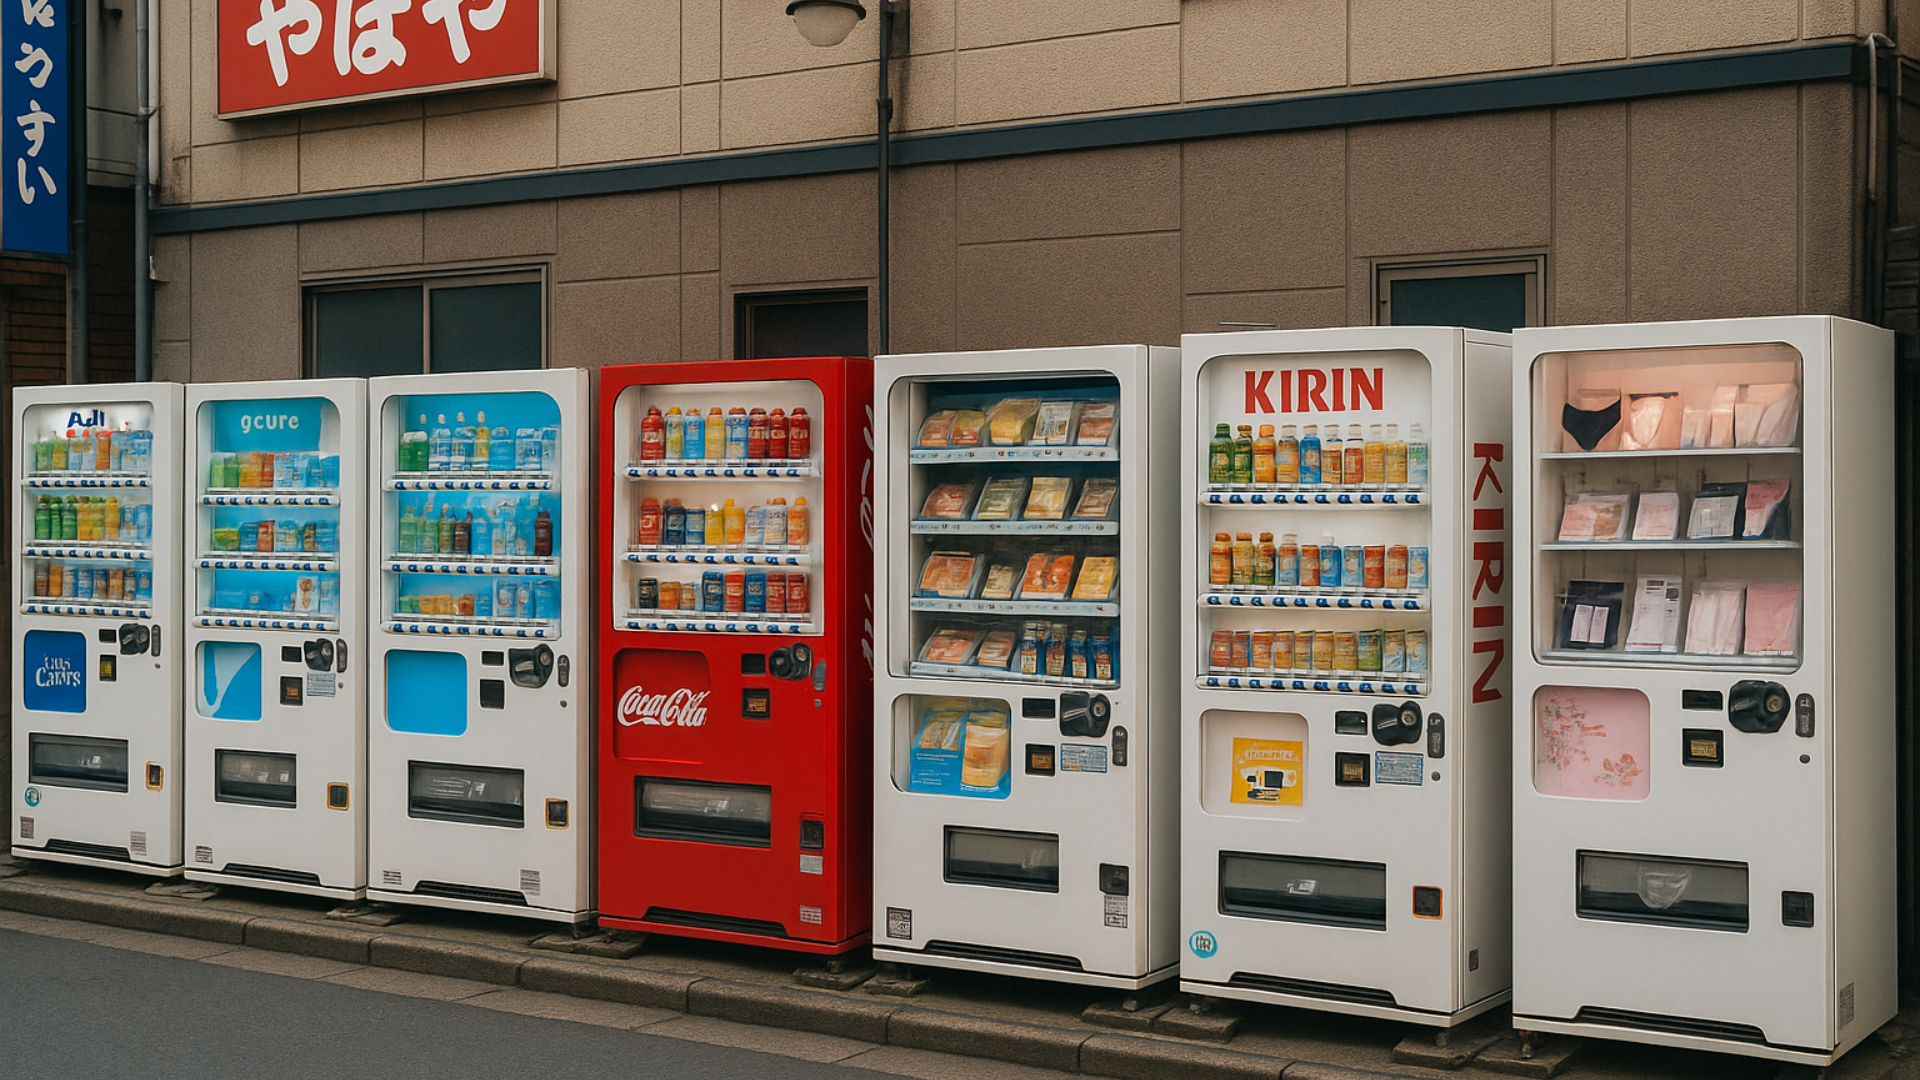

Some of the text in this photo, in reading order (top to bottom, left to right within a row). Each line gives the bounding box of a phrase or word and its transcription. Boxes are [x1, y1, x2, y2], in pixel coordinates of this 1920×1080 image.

[1244, 367, 1384, 414] KIRIN
[240, 414, 300, 434] gcure
[1472, 442, 1505, 704] KIRIN
